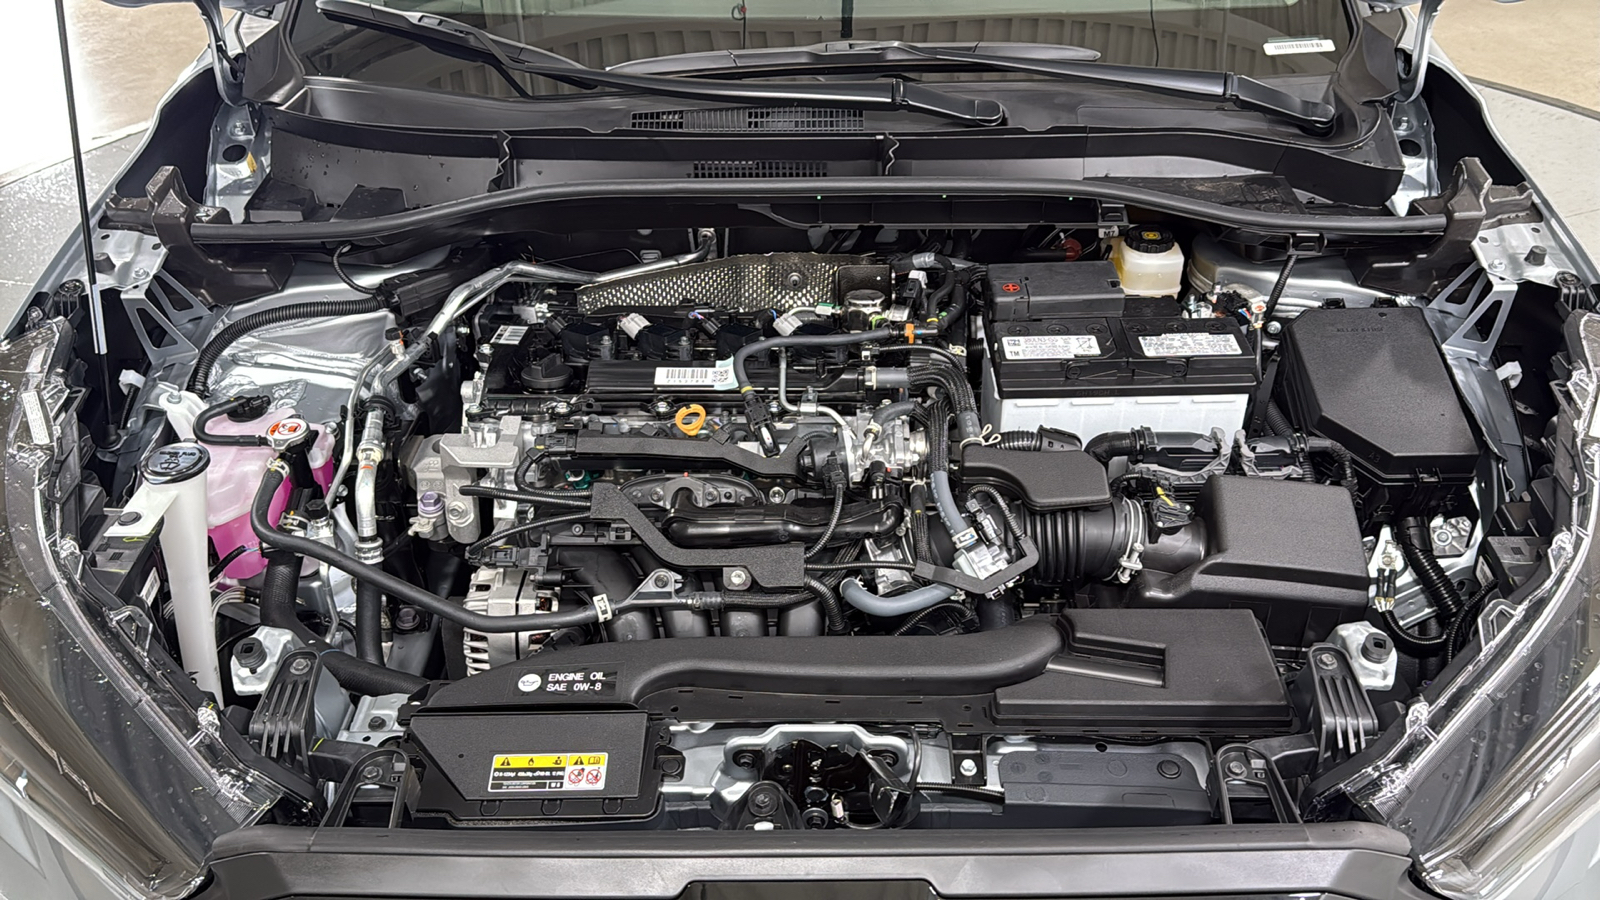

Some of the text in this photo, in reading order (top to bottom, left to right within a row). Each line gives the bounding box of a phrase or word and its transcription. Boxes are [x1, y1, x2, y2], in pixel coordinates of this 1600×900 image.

[1103, 230, 1115, 238] M7
[548, 671, 606, 681] ENGINE OIL
[546, 682, 602, 692] SAE 0W-8
